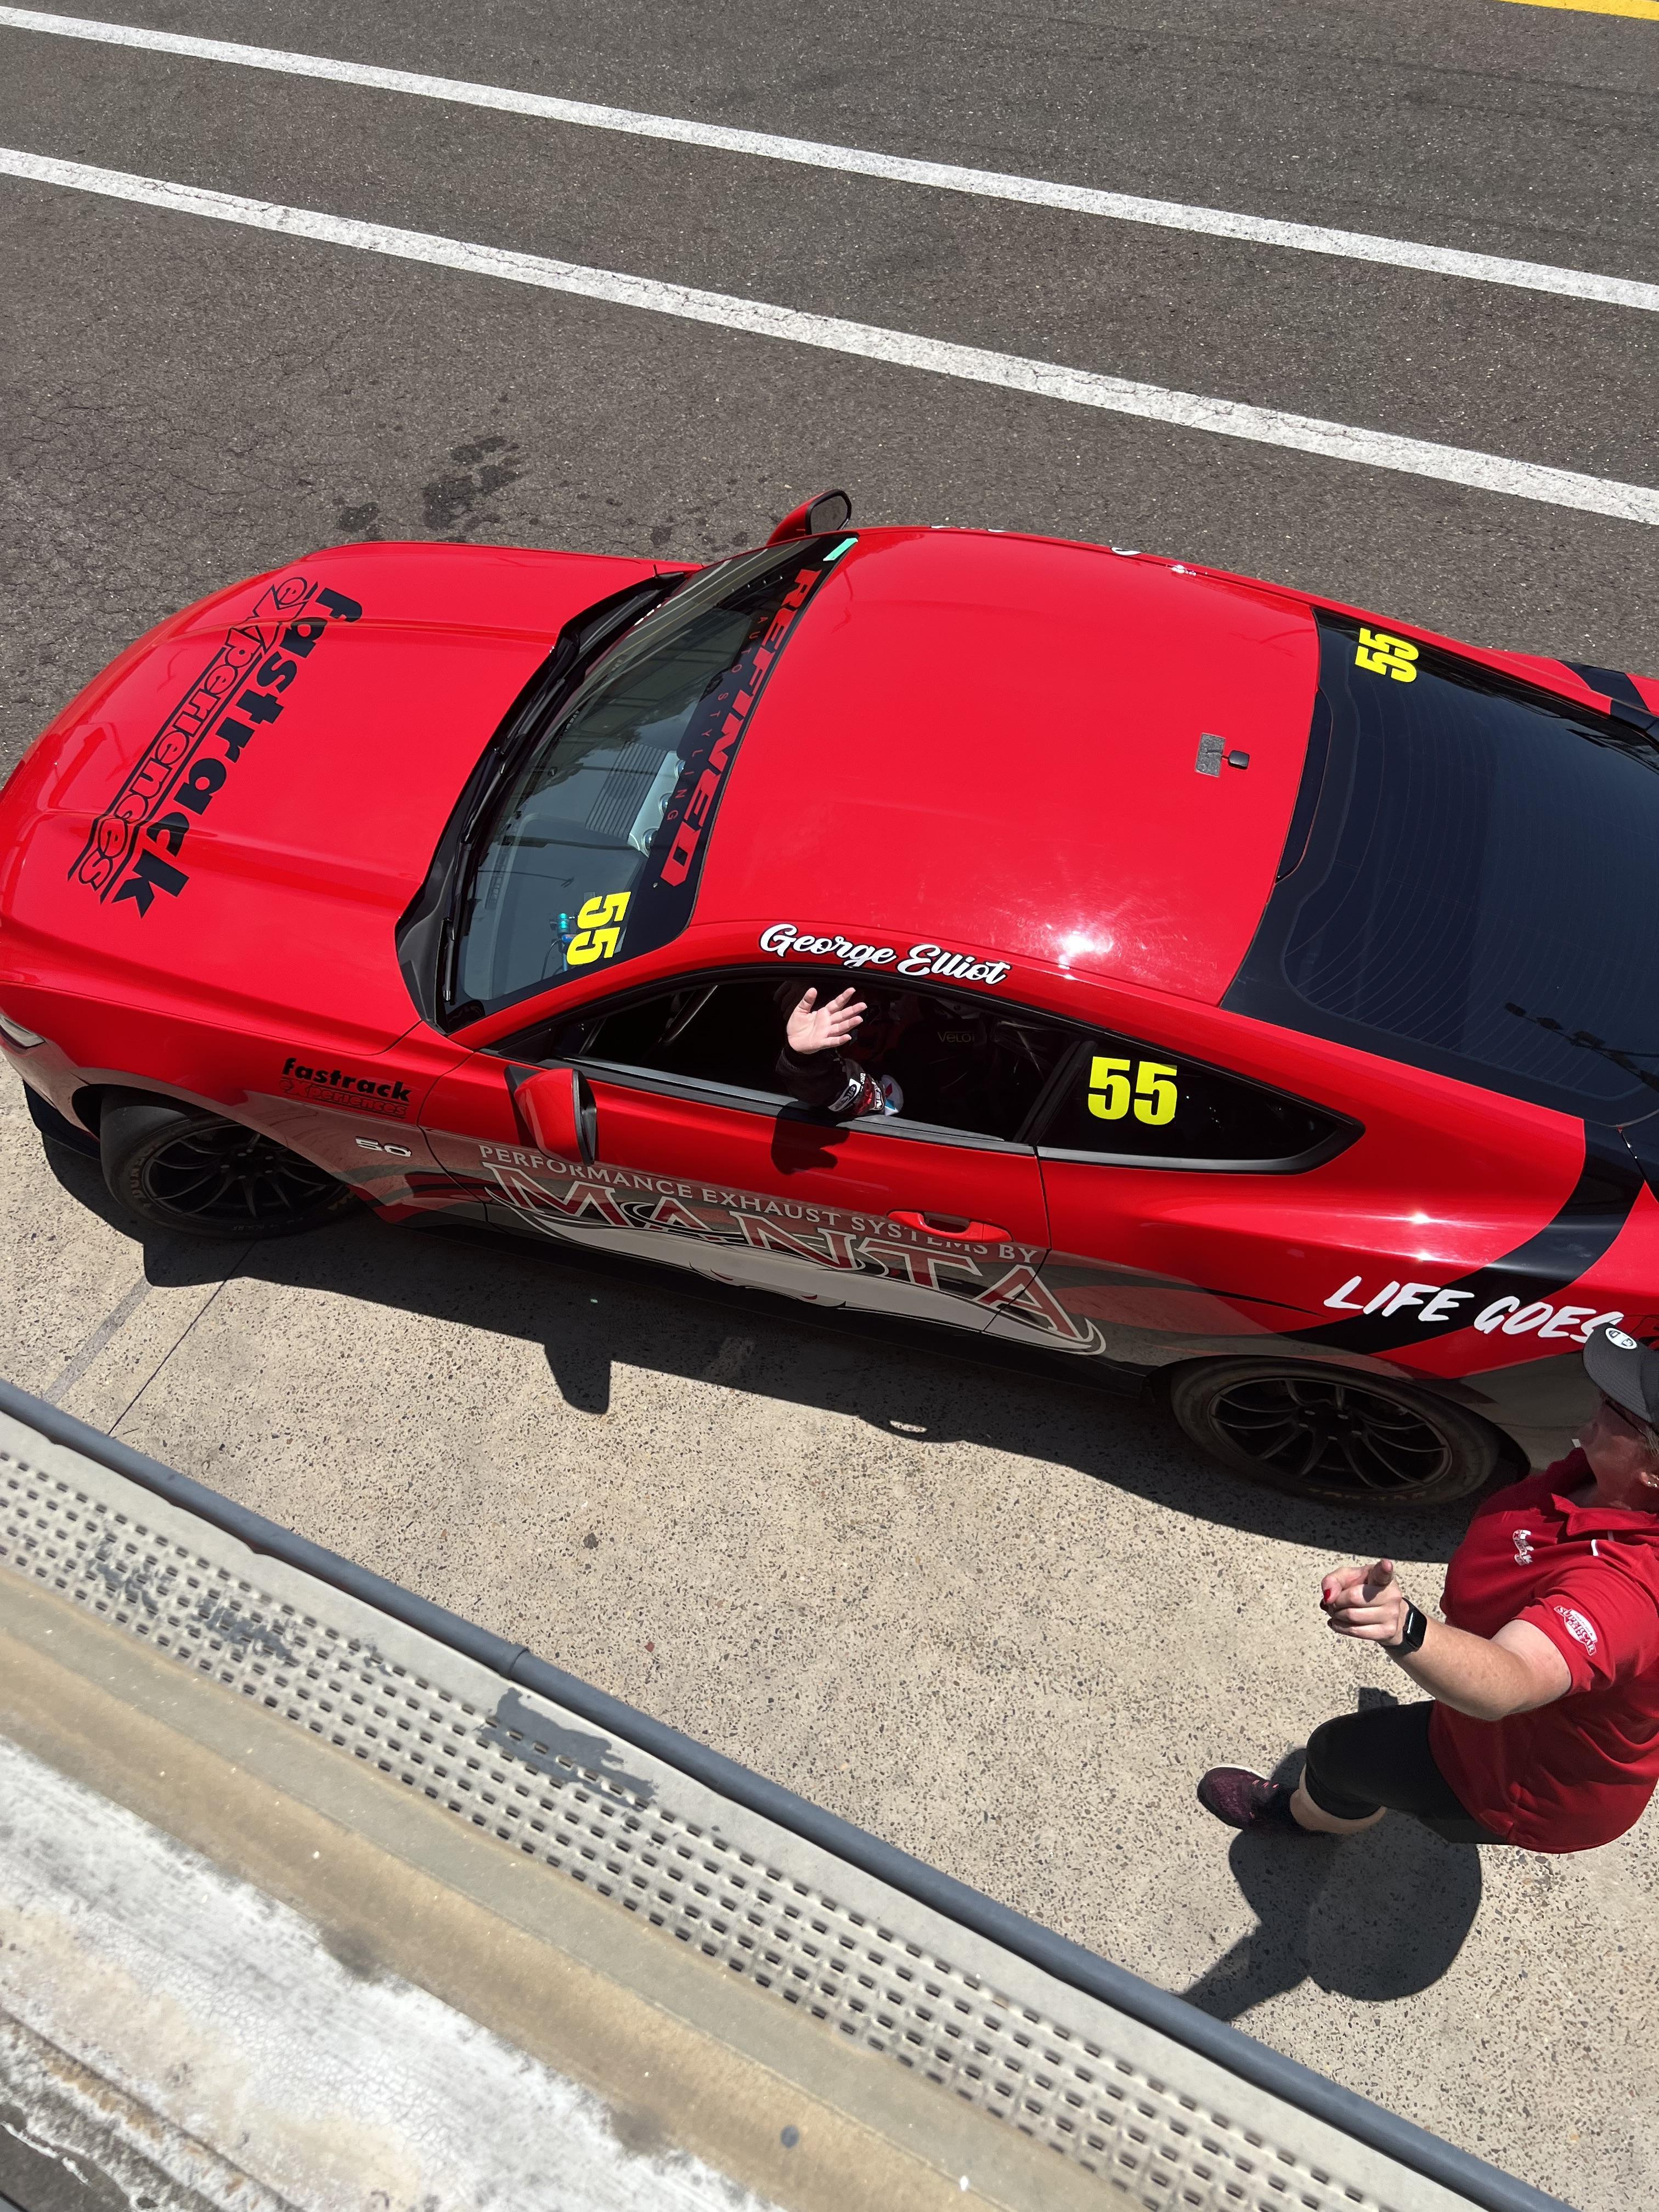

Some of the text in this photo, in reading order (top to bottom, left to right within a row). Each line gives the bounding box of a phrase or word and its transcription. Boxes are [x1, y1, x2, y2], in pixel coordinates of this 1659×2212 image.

[1355, 628, 1419, 682] 55
[659, 569, 823, 887] REFINED
[666, 616, 768, 821] AUTO STYLING
[566, 891, 631, 966] 55
[760, 924, 1012, 986] George Elliot
[282, 1058, 412, 1102] fastrack
[1088, 1057, 1177, 1125] 55
[479, 1144, 693, 1199] PERFORMANCE
[701, 1188, 840, 1226] EXHAUST
[998, 1243, 1037, 1263] BY
[482, 1162, 1106, 1355] MANTA
[1323, 1276, 1475, 1322] LIFE
